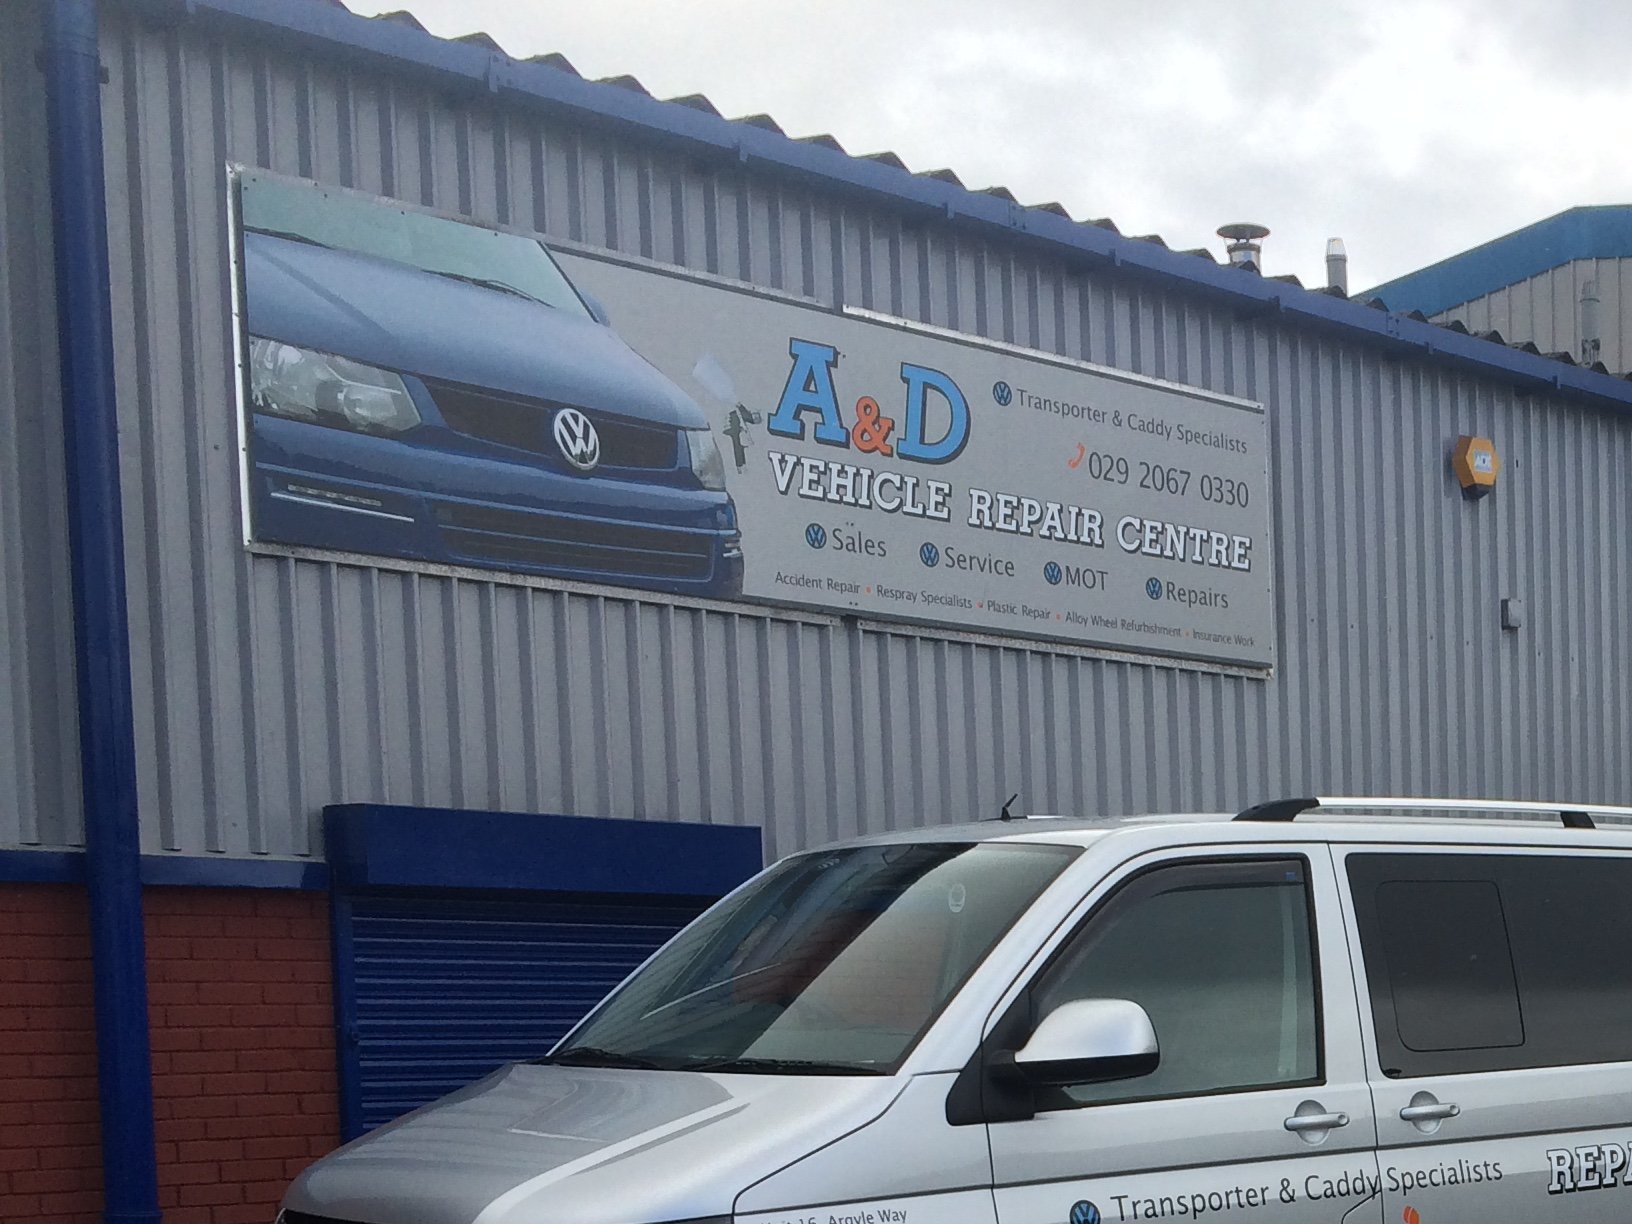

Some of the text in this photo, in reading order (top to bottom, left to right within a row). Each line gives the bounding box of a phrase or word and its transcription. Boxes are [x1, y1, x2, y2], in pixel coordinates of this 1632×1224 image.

[767, 337, 971, 465] A&D
[1017, 388, 1106, 423] Transporter
[1112, 410, 1123, 427] &
[1127, 414, 1172, 440] Caddy
[1177, 424, 1248, 454] Specialists
[1089, 451, 1249, 508] 029 2067 0330
[769, 451, 1252, 572] VEHICLE REPAIR CENTRE
[832, 528, 887, 557] Sales
[945, 547, 1015, 578] Service
[1065, 565, 1108, 591] MOT
[1166, 581, 1229, 608] Repairs
[775, 571, 1255, 647] Accident Repair Respray Specialists Plastic Repair Alloy Wheel Refurbishment Insurance Work
[879, 1208, 907, 1224] Way
[1110, 1185, 1269, 1221] Transporter
[1279, 1177, 1297, 1203] &
[1304, 1169, 1380, 1201] Caddy
[1387, 1159, 1503, 1198] Specialists
